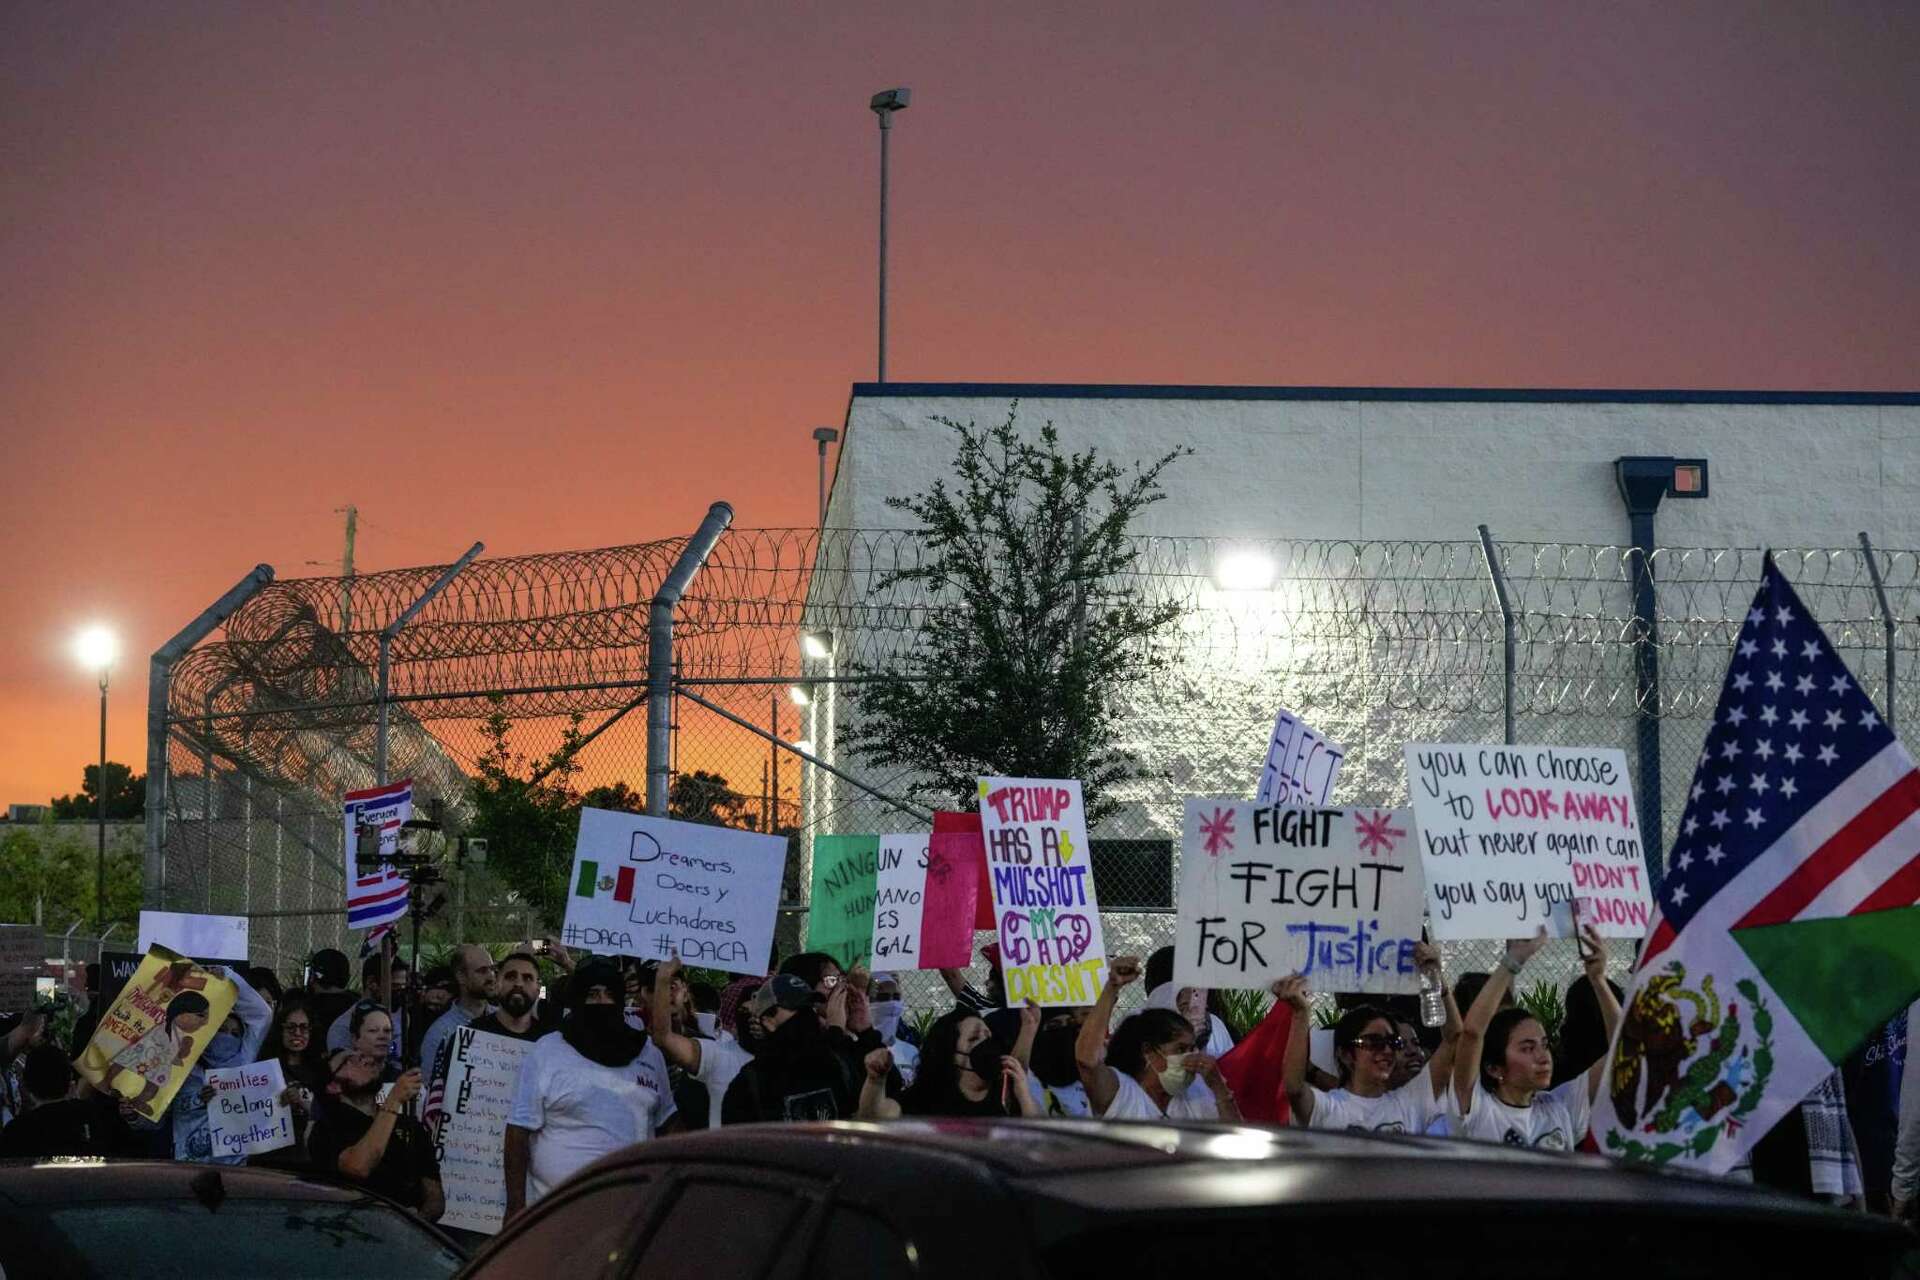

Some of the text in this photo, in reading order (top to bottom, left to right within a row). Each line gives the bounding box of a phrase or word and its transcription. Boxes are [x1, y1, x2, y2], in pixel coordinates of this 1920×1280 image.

[1268, 716, 1343, 806] ELECT
[1418, 750, 1618, 798] you can choose
[987, 786, 1072, 824] TRUMP
[1444, 791, 1474, 820] to
[1486, 788, 1559, 820] LOOK
[630, 831, 736, 876] Dreamers,
[989, 826, 1062, 868] HAS A
[1425, 828, 1639, 865] but never again can
[657, 874, 730, 903] Doers y
[823, 848, 903, 898] NINGUN
[994, 865, 1087, 908] MUGSHOT
[1230, 862, 1404, 912] FIGHT
[1572, 863, 1640, 892] DIDN'T
[629, 898, 737, 935] Luchadores
[844, 888, 922, 919] HUMANO
[1434, 880, 1575, 921] you say you
[878, 910, 900, 929] ES
[1029, 908, 1057, 941] MY
[564, 923, 750, 963] #DACA #DACA
[209, 1070, 269, 1091] Families
[221, 1095, 273, 1118] Belong
[212, 1117, 287, 1154] Together!
